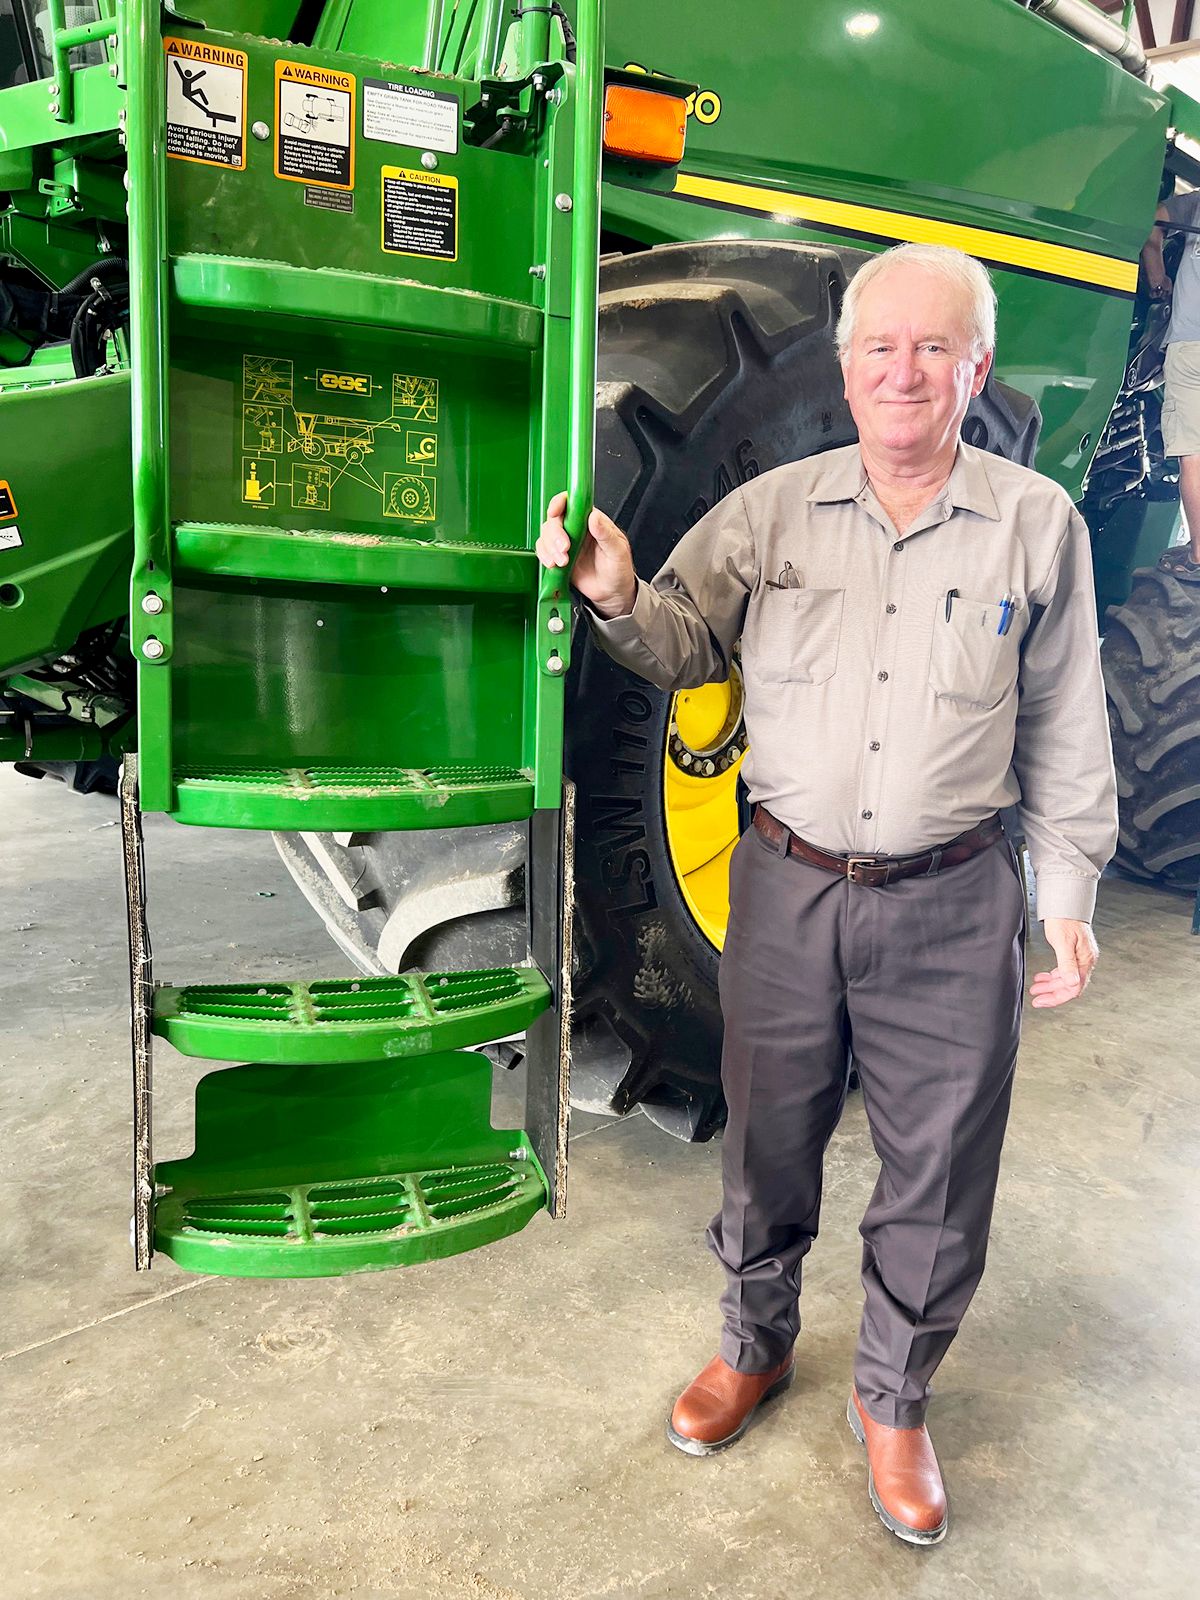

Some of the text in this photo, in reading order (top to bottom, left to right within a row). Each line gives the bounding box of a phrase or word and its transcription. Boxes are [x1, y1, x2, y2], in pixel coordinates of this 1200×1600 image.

[181, 43, 244, 67] WARNING
[294, 68, 350, 88] WARNING
[388, 83, 435, 98] TIRE LOADING
[168, 124, 238, 144] Avoid serious injury
[168, 131, 184, 139] from
[186, 135, 210, 145] falling.
[224, 142, 235, 150] not
[168, 138, 226, 155] ride ladder while
[168, 144, 195, 155] combine
[204, 152, 229, 162] moving.
[409, 173, 441, 184] CAUTION
[589, 795, 659, 919] LSW
